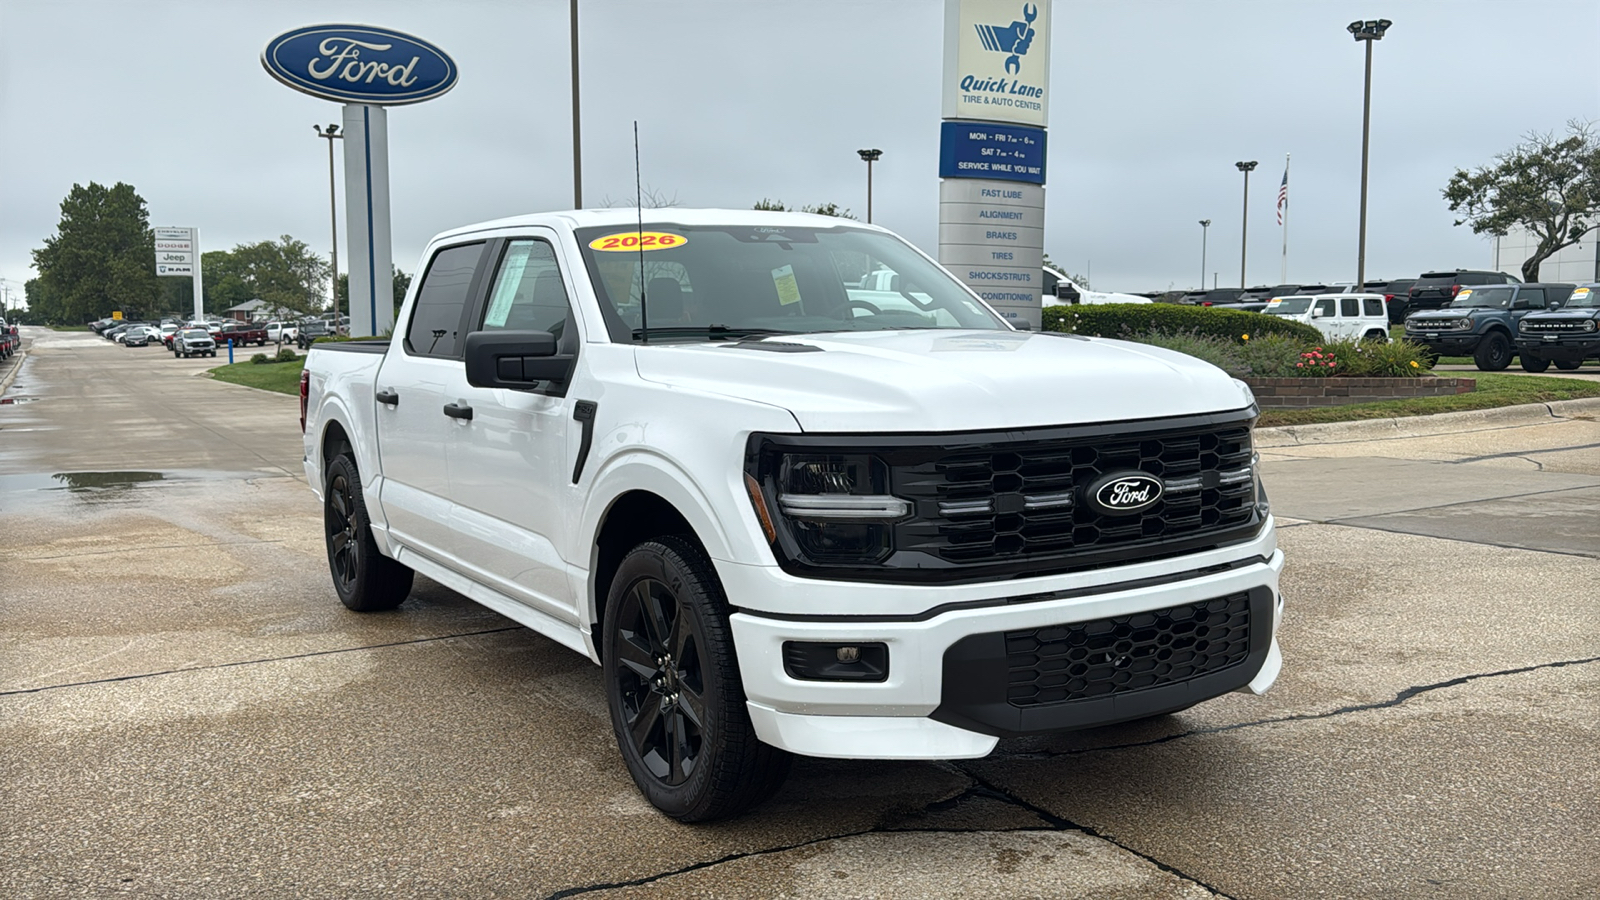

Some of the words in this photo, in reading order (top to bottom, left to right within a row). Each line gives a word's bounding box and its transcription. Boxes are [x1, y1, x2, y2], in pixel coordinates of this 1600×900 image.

[308, 37, 420, 87] Ford
[960, 75, 1008, 93] Quick
[1009, 80, 1043, 98] Lane
[962, 95, 982, 104] TIRE
[991, 97, 1013, 107] AUTO
[1014, 99, 1041, 111] CENTER
[969, 132, 987, 140] MON
[995, 133, 1006, 142] FRI
[981, 147, 994, 156] SAT
[958, 162, 989, 171] SERVICE
[991, 163, 1012, 172] WHILE
[1014, 165, 1026, 173] YOU
[1028, 166, 1041, 175] WAIT
[981, 189, 1001, 198] FAST
[1003, 190, 1022, 199] LUBE
[979, 210, 1023, 220] ALIGNMENT
[986, 231, 1017, 240] BRAKES
[602, 235, 676, 249] 2026
[163, 253, 185, 262] Jeep
[991, 252, 1013, 260] TIRES
[969, 271, 1031, 281] SHOCKS/STRUTS
[981, 292, 1033, 301] CONDITIONING
[1110, 481, 1150, 505] Ford
